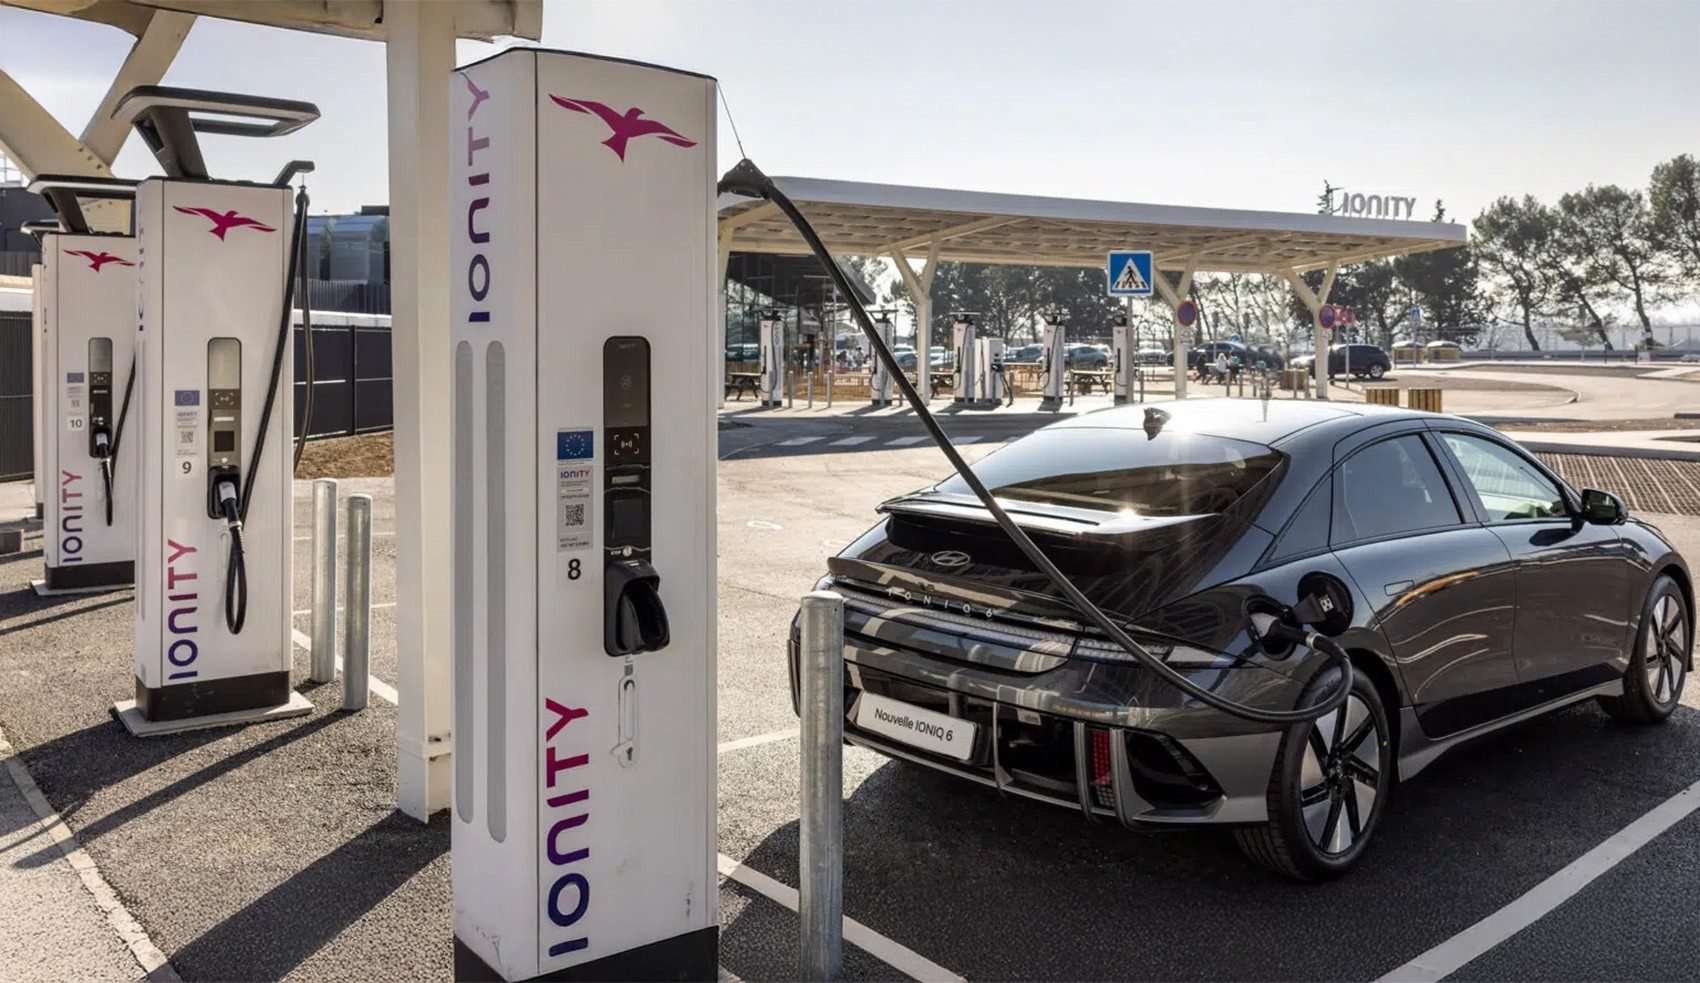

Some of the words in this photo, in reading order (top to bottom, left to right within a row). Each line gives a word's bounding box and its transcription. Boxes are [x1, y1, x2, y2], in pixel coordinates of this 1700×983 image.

[467, 79, 491, 322] IONITY
[1343, 192, 1416, 217] IONITY
[70, 419, 83, 428] 10
[182, 461, 192, 474] 9
[561, 470, 590, 478] IONITY
[62, 470, 82, 562] IONITY
[567, 558, 581, 580] 8
[168, 539, 198, 680] IONITY
[874, 708, 914, 730] Nouvelle
[915, 720, 944, 741] IONIQ
[945, 730, 953, 742] 6
[546, 697, 589, 957] IONITY
